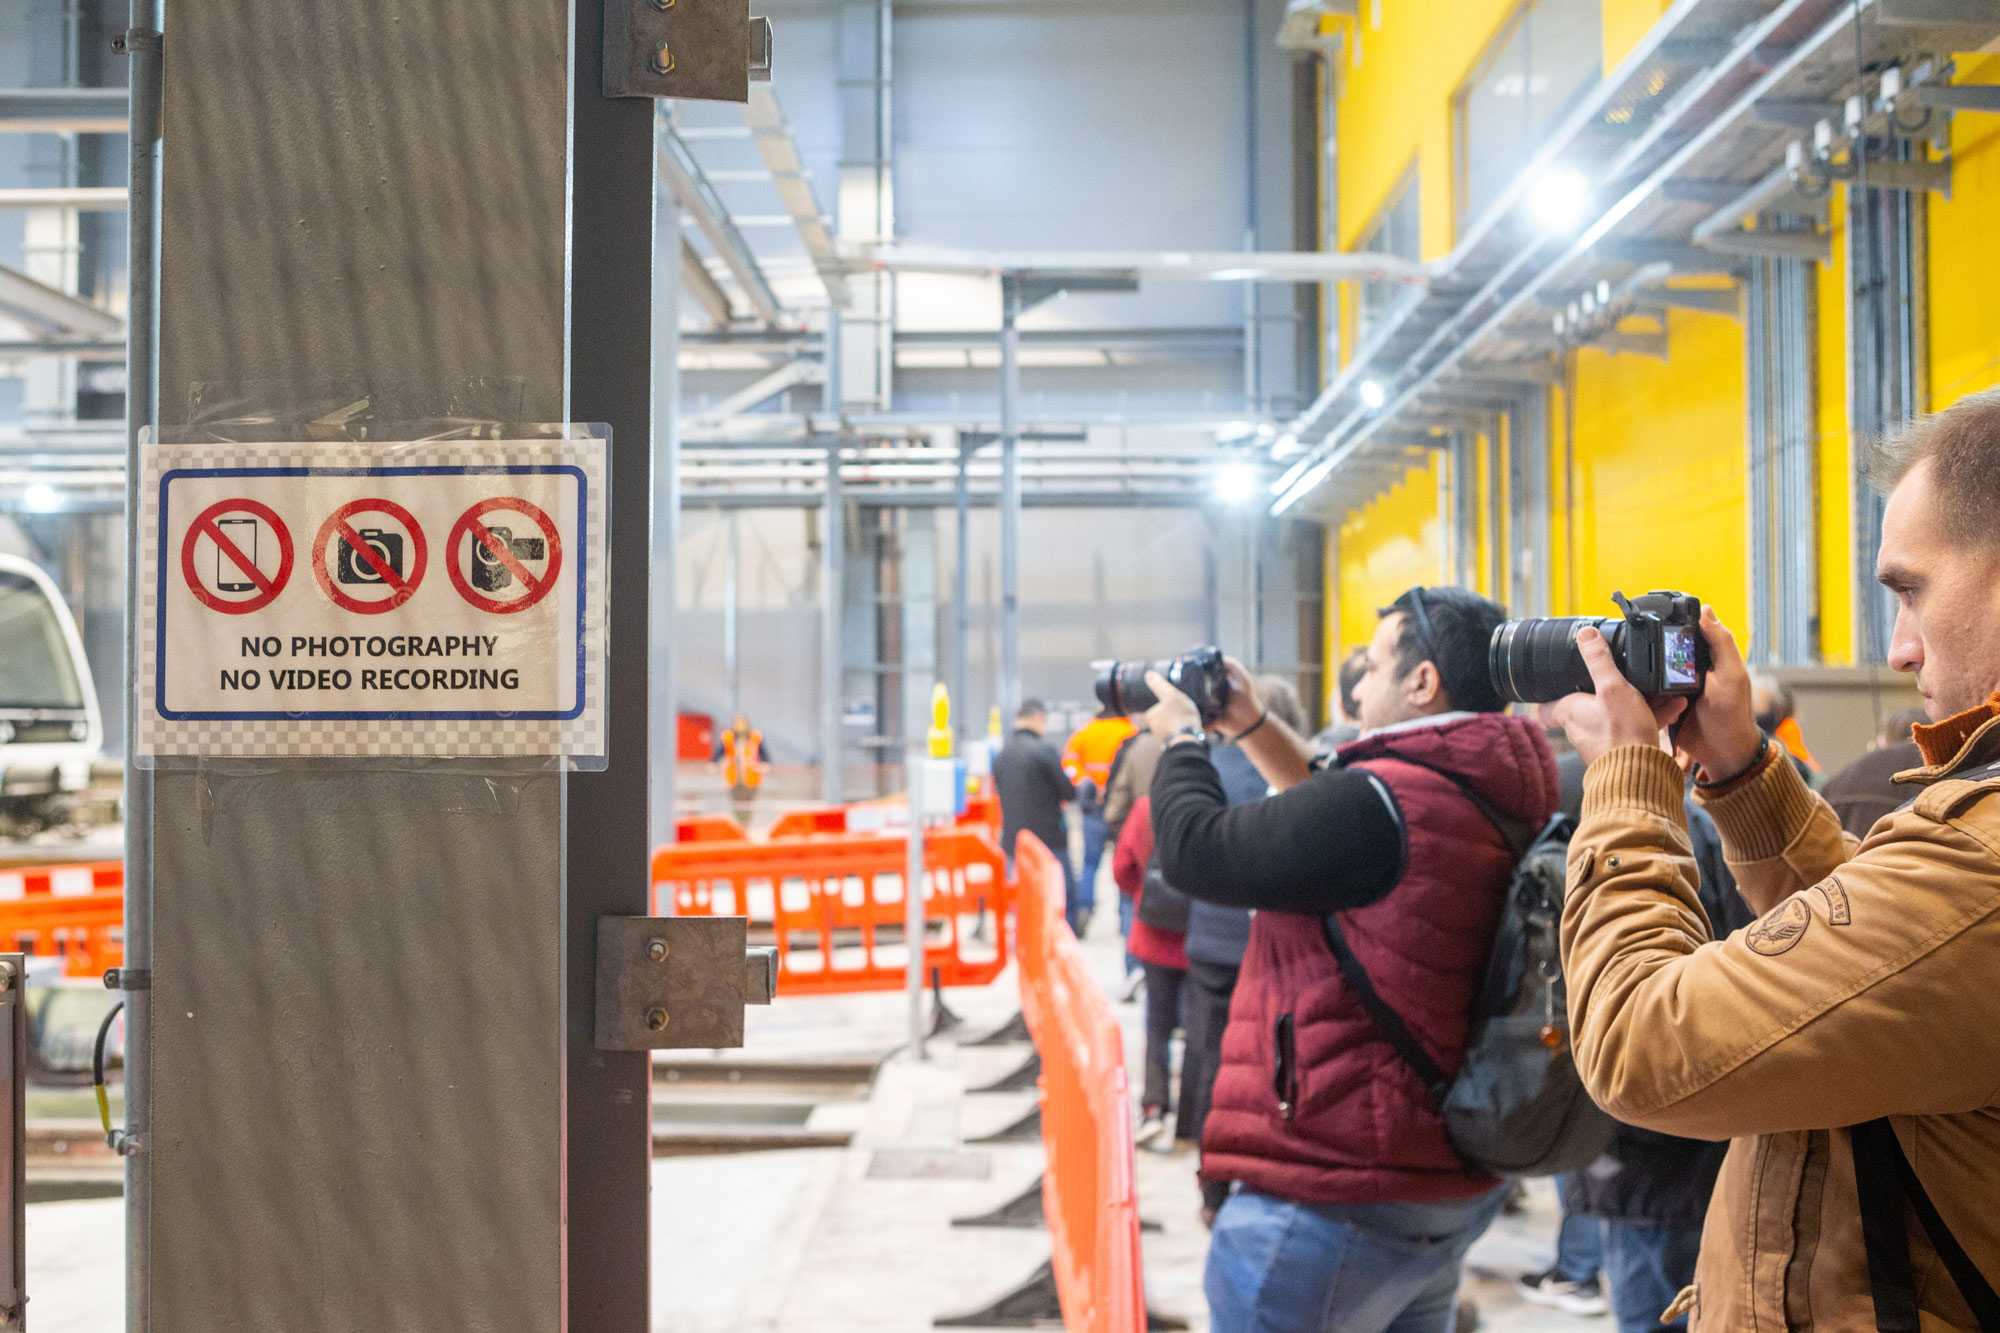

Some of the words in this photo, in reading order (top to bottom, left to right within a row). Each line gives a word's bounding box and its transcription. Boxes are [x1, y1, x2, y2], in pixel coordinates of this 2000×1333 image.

[241, 636, 281, 657] NO
[291, 635, 498, 657] PHOTOGRAPHY
[220, 669, 260, 690] NO
[268, 669, 352, 690] VIDEO
[361, 668, 519, 690] RECORDING
